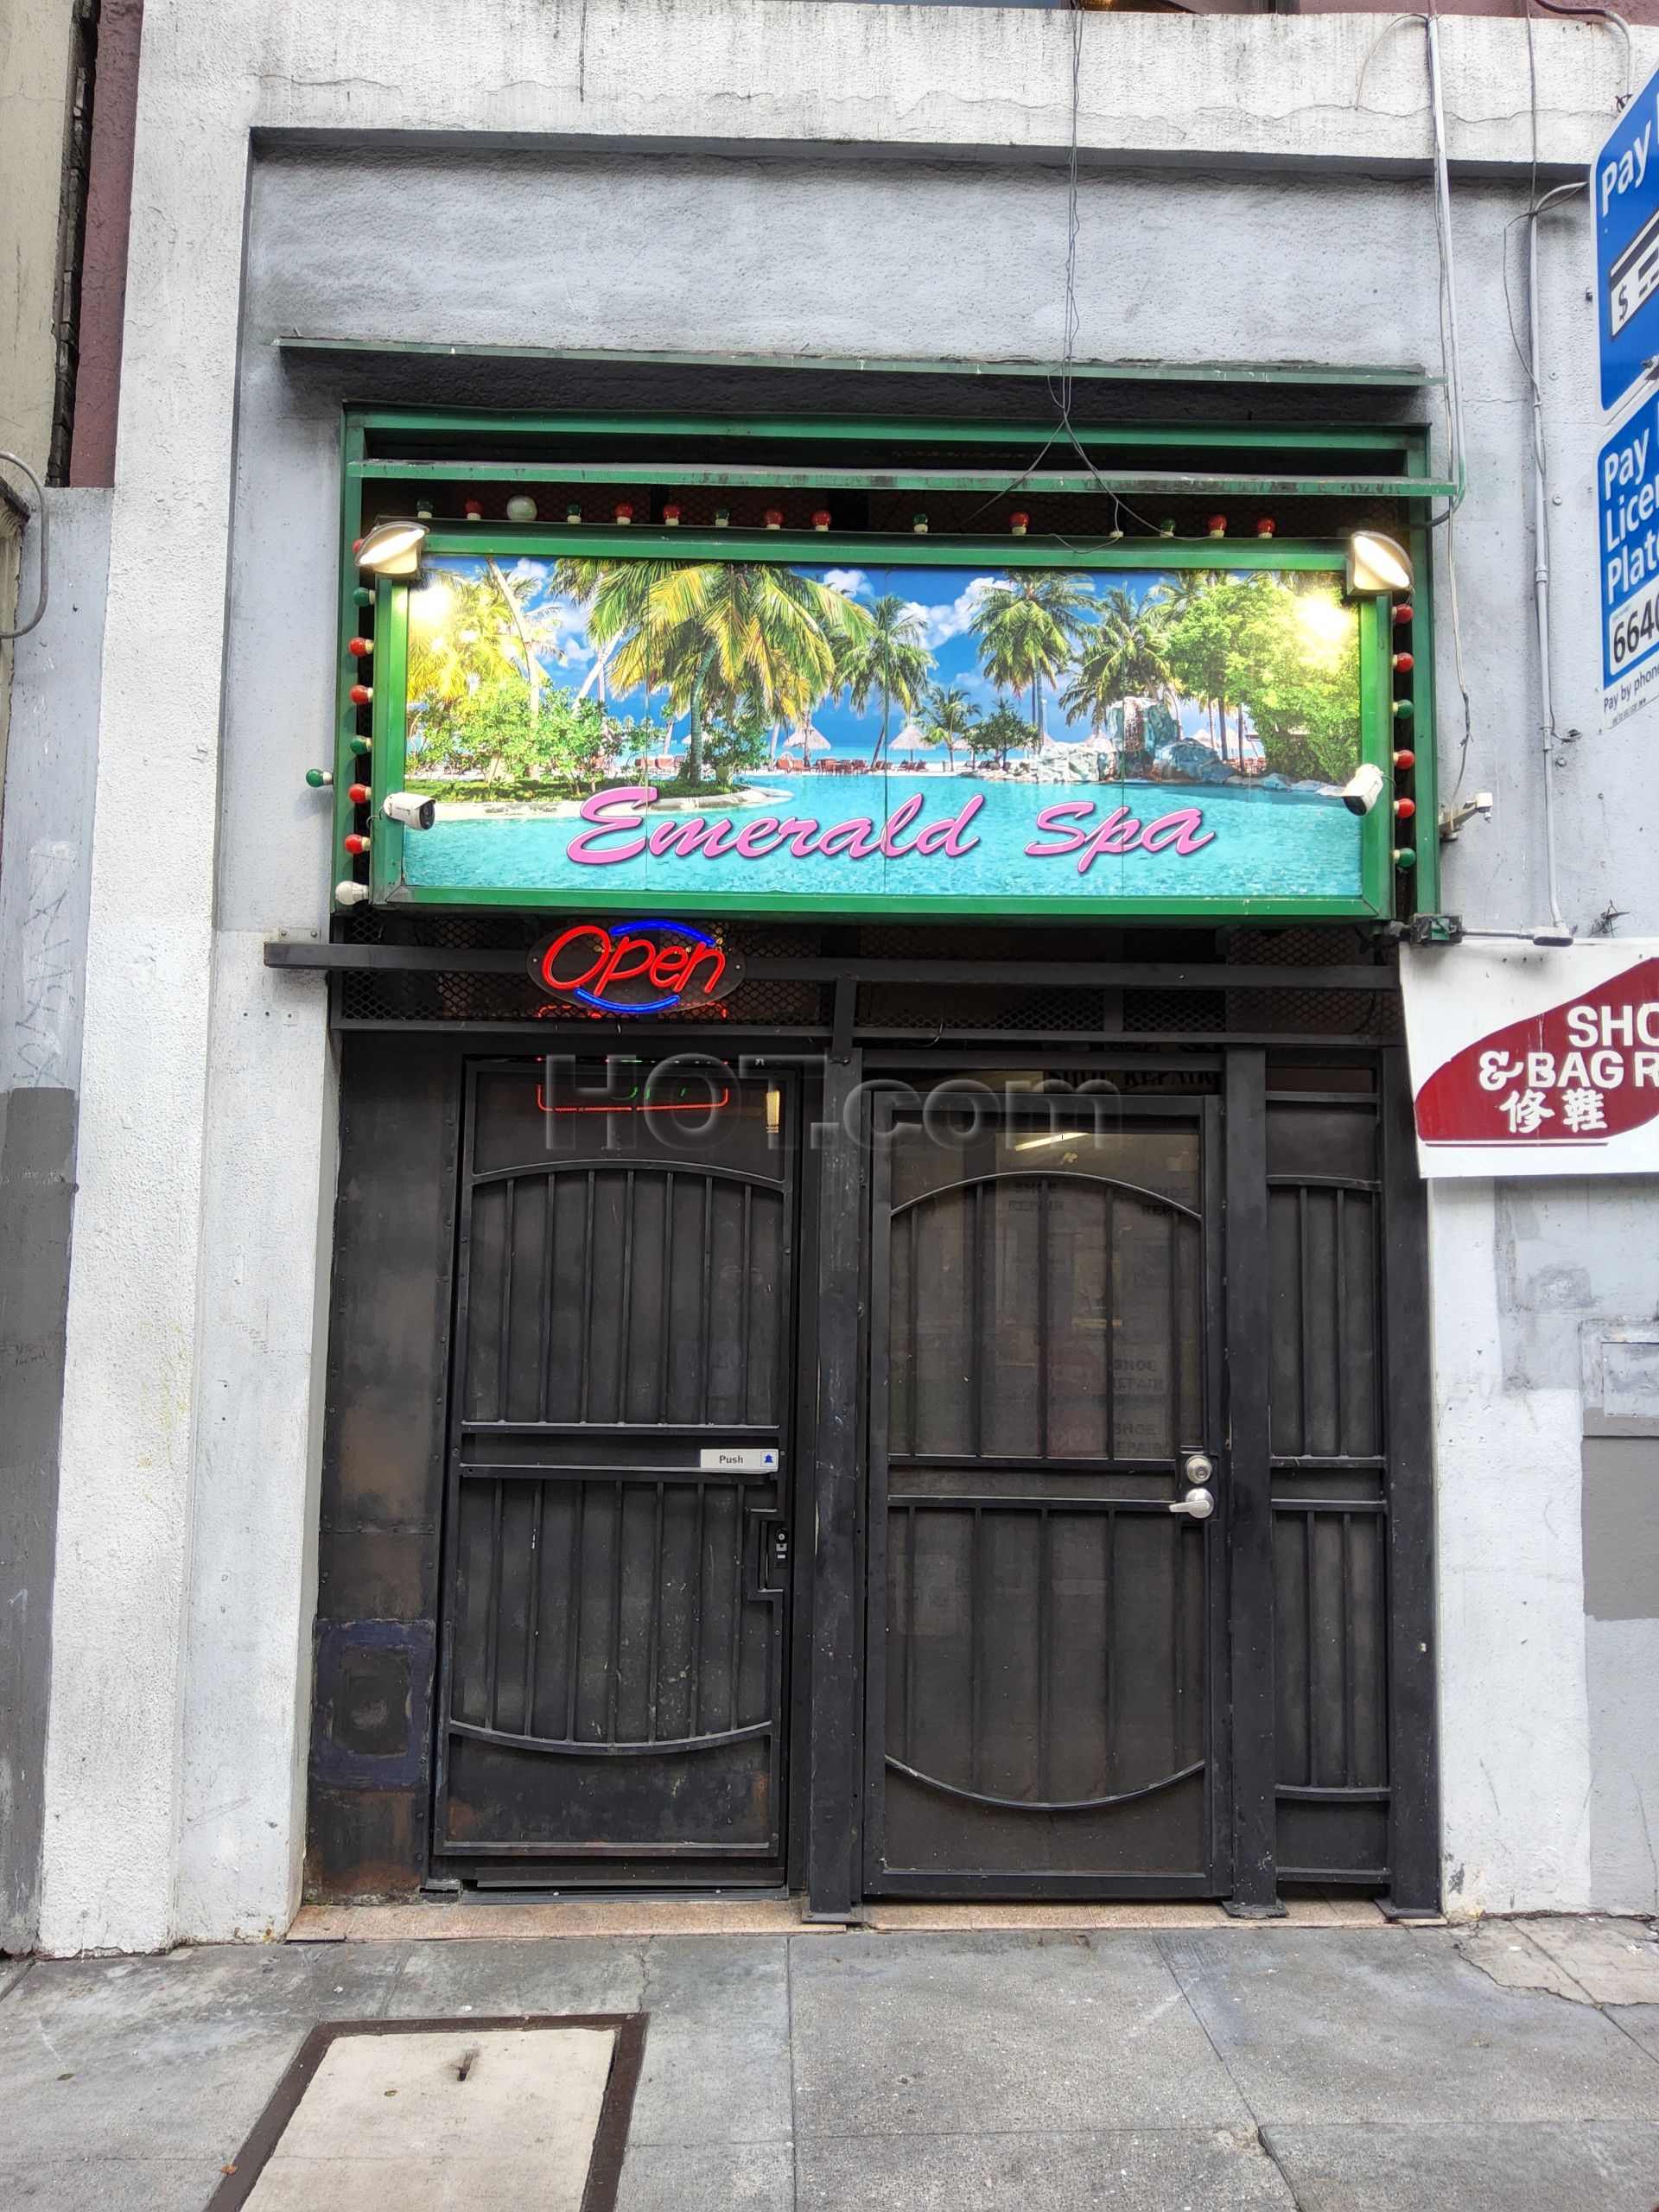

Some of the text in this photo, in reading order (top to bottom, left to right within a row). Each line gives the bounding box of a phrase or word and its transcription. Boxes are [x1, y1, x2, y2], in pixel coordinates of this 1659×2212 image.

[1601, 119, 1651, 217] Pay
[1604, 427, 1649, 501] Pay
[1607, 531, 1659, 605] Plat
[1604, 694, 1618, 713] Pay
[1621, 684, 1631, 701] by
[565, 785, 1215, 875] Emerald Spa
[542, 925, 726, 996] Open
[719, 1455, 744, 1464] Push
